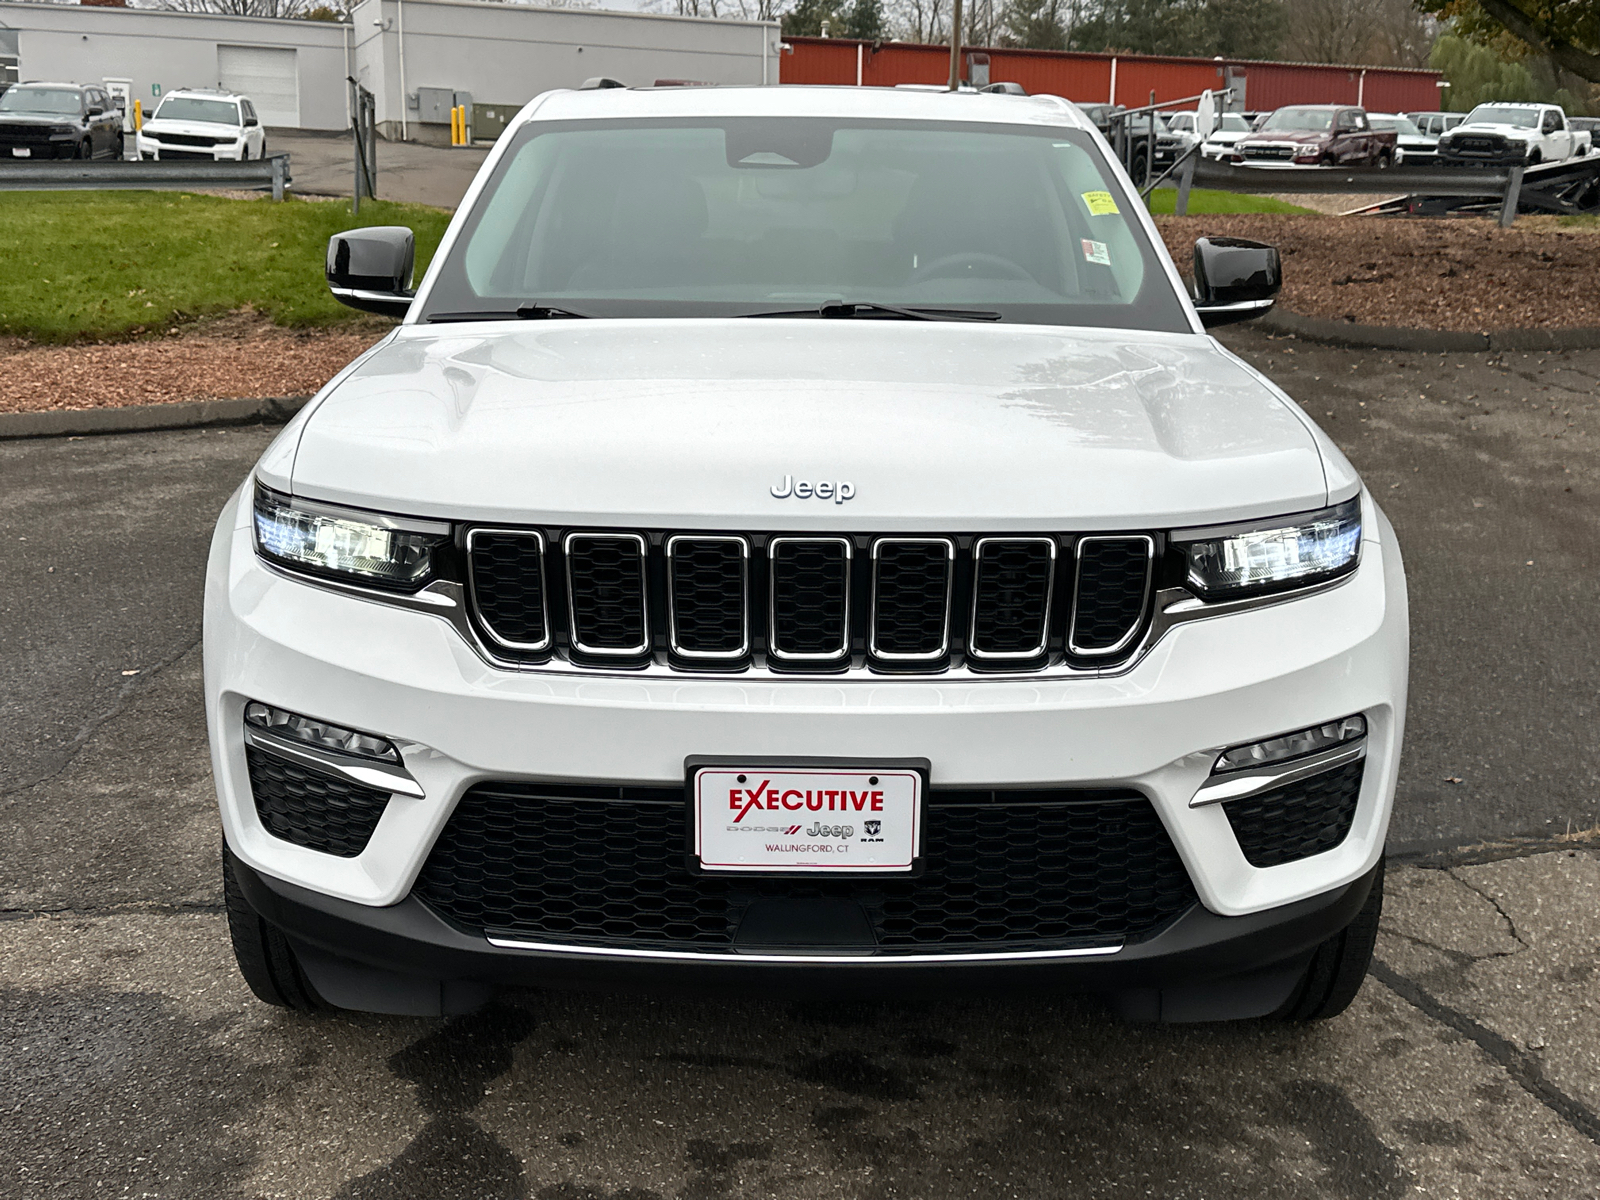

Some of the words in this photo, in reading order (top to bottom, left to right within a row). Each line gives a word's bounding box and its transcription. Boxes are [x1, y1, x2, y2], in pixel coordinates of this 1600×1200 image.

[770, 474, 856, 505] Jeep
[729, 780, 884, 823] EXECUTIVE
[726, 825, 791, 833] DODGE
[806, 822, 854, 839] Jeep
[765, 843, 835, 854] WALLINGFORD,
[837, 845, 850, 853] CT
